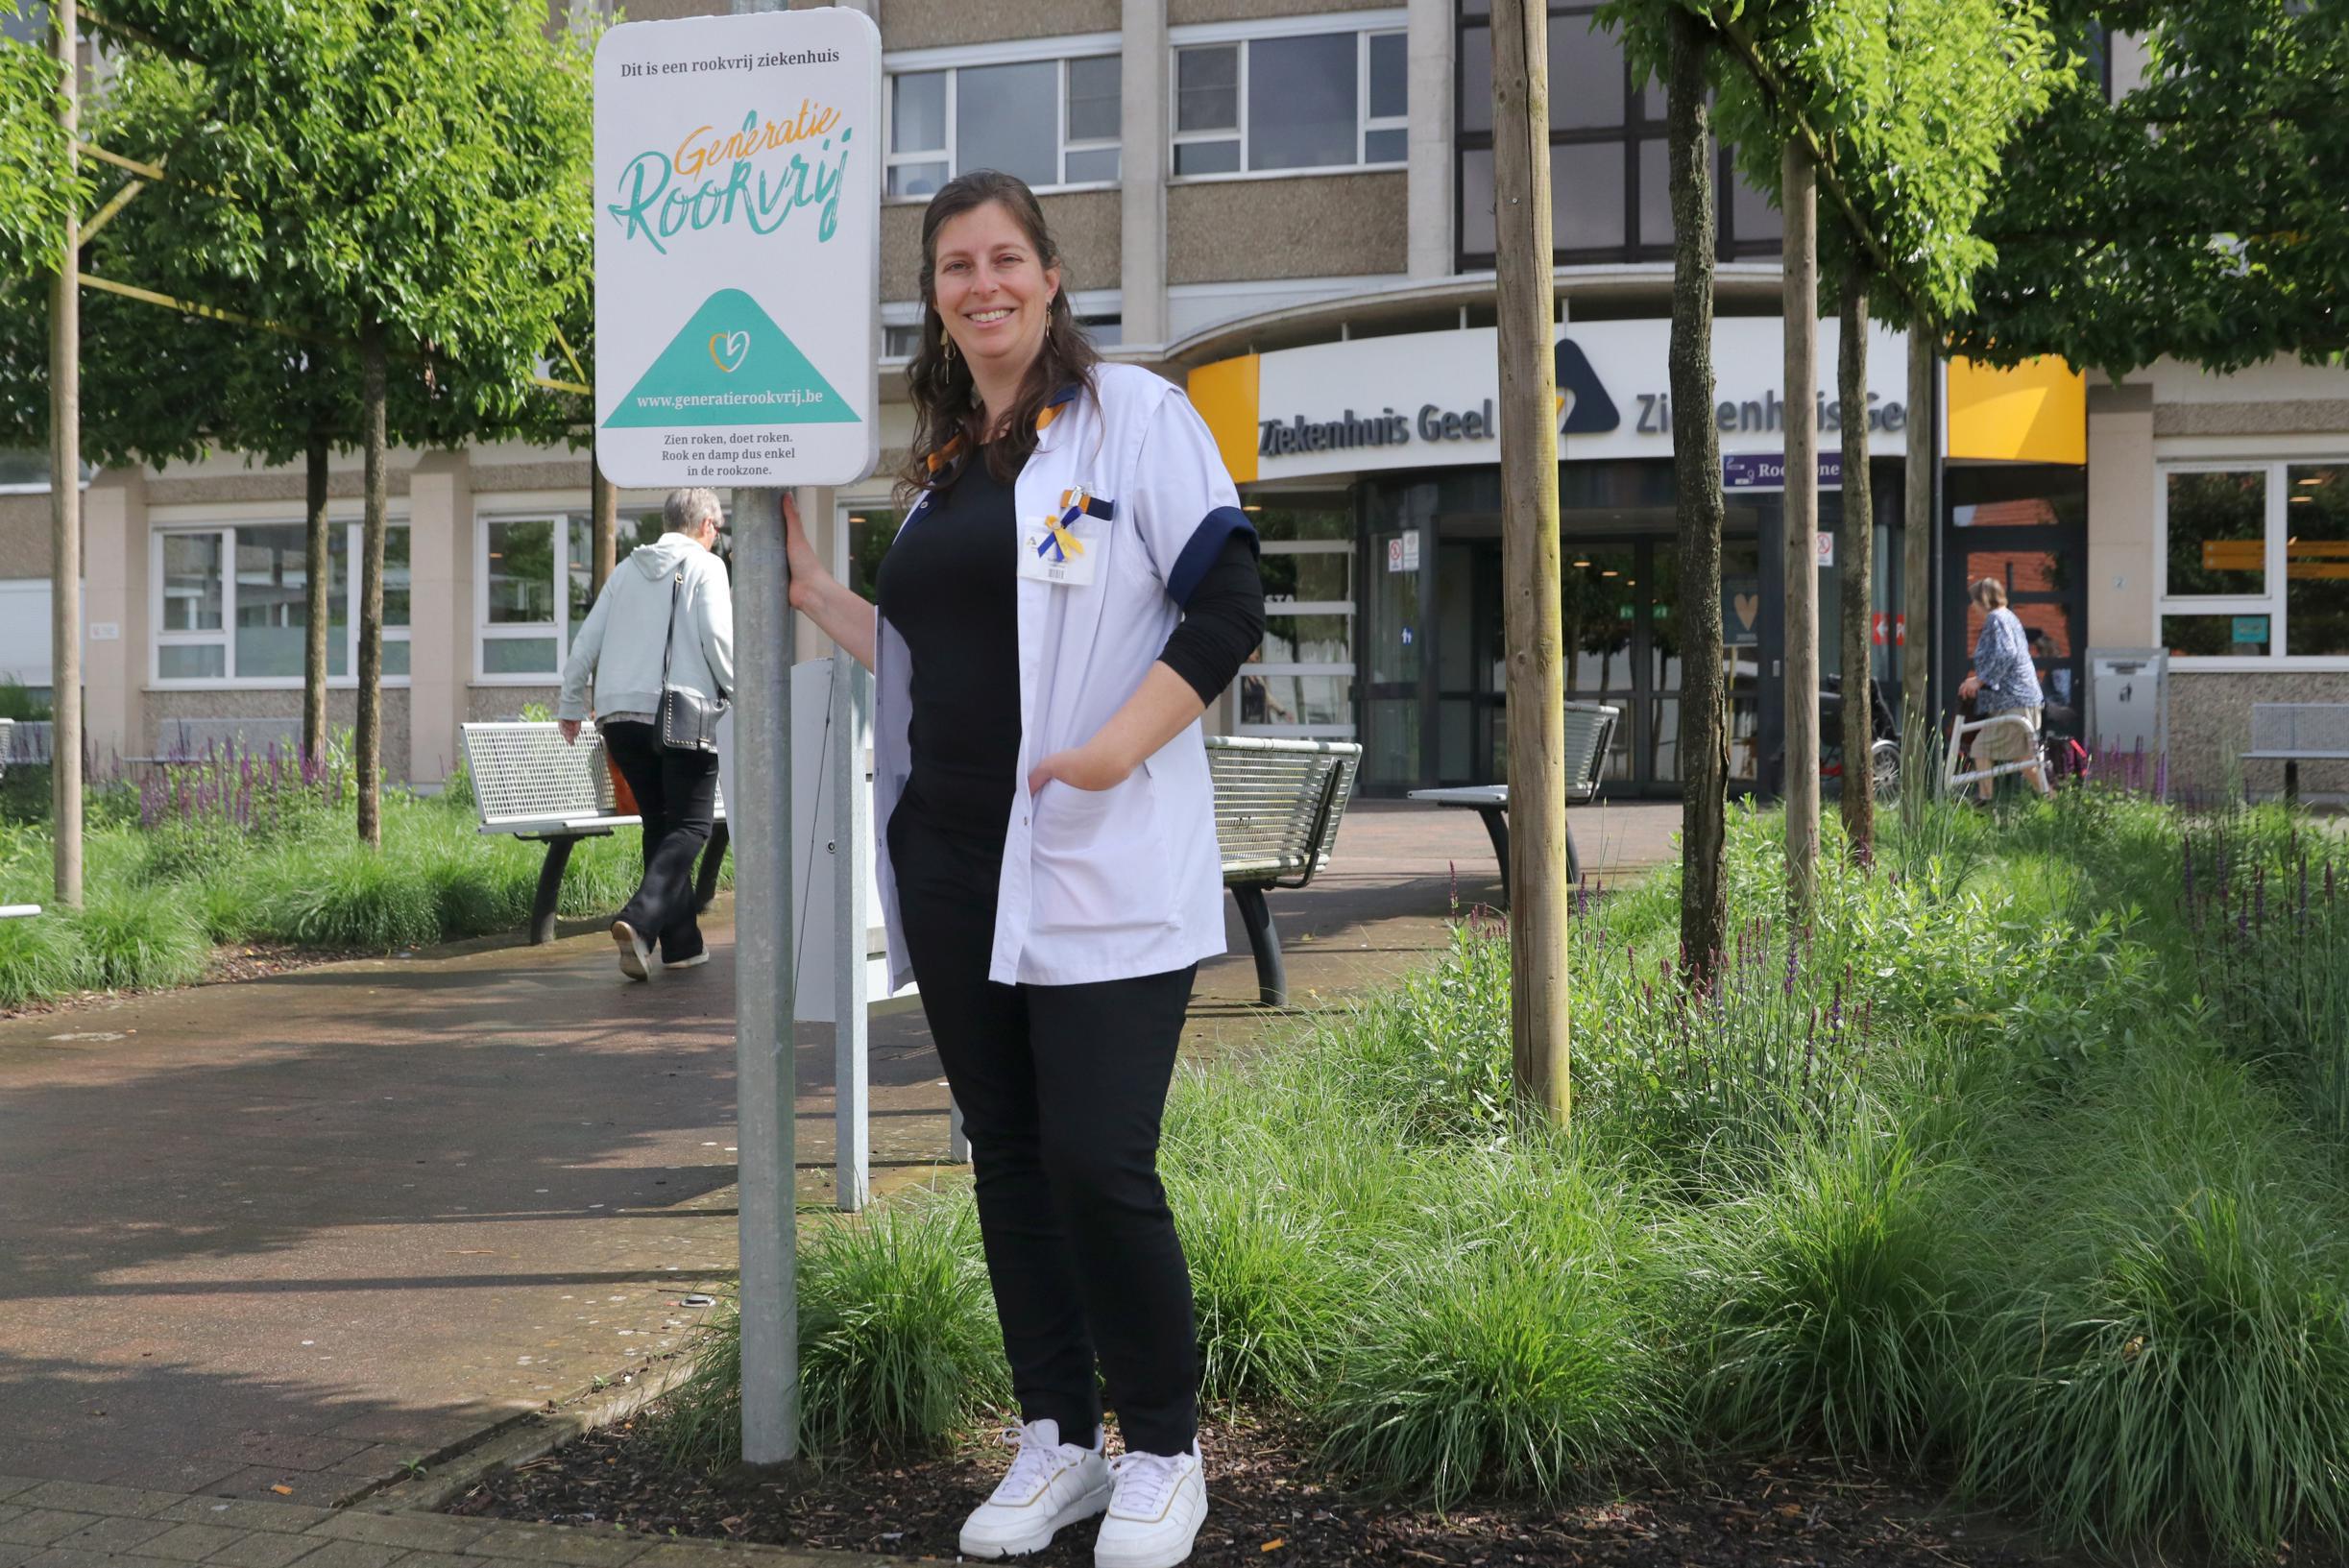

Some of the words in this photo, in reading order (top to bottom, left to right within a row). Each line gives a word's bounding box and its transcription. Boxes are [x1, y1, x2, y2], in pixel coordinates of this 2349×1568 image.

[620, 61, 642, 77] Dit
[646, 61, 659, 76] is
[662, 60, 688, 74] een
[691, 54, 753, 72] rookvrij
[757, 48, 840, 67] ziekenhuis
[673, 98, 841, 183] Generatie
[637, 390, 823, 410] www.generatierookvrij.be
[1635, 389, 1842, 433] Zienhis
[664, 434, 689, 446] Zien
[690, 433, 727, 446] roken,
[729, 432, 754, 444] doet
[757, 432, 793, 444] roken.
[1259, 407, 1410, 457] Ziekenhuis
[1417, 398, 1494, 442] Geel
[662, 450, 690, 461] Rook
[691, 452, 706, 461] en
[708, 449, 739, 462] damp
[741, 448, 762, 460] dus
[764, 447, 795, 459] enkel
[688, 465, 698, 476] in
[701, 465, 714, 476] de
[716, 465, 772, 476] rookzone.
